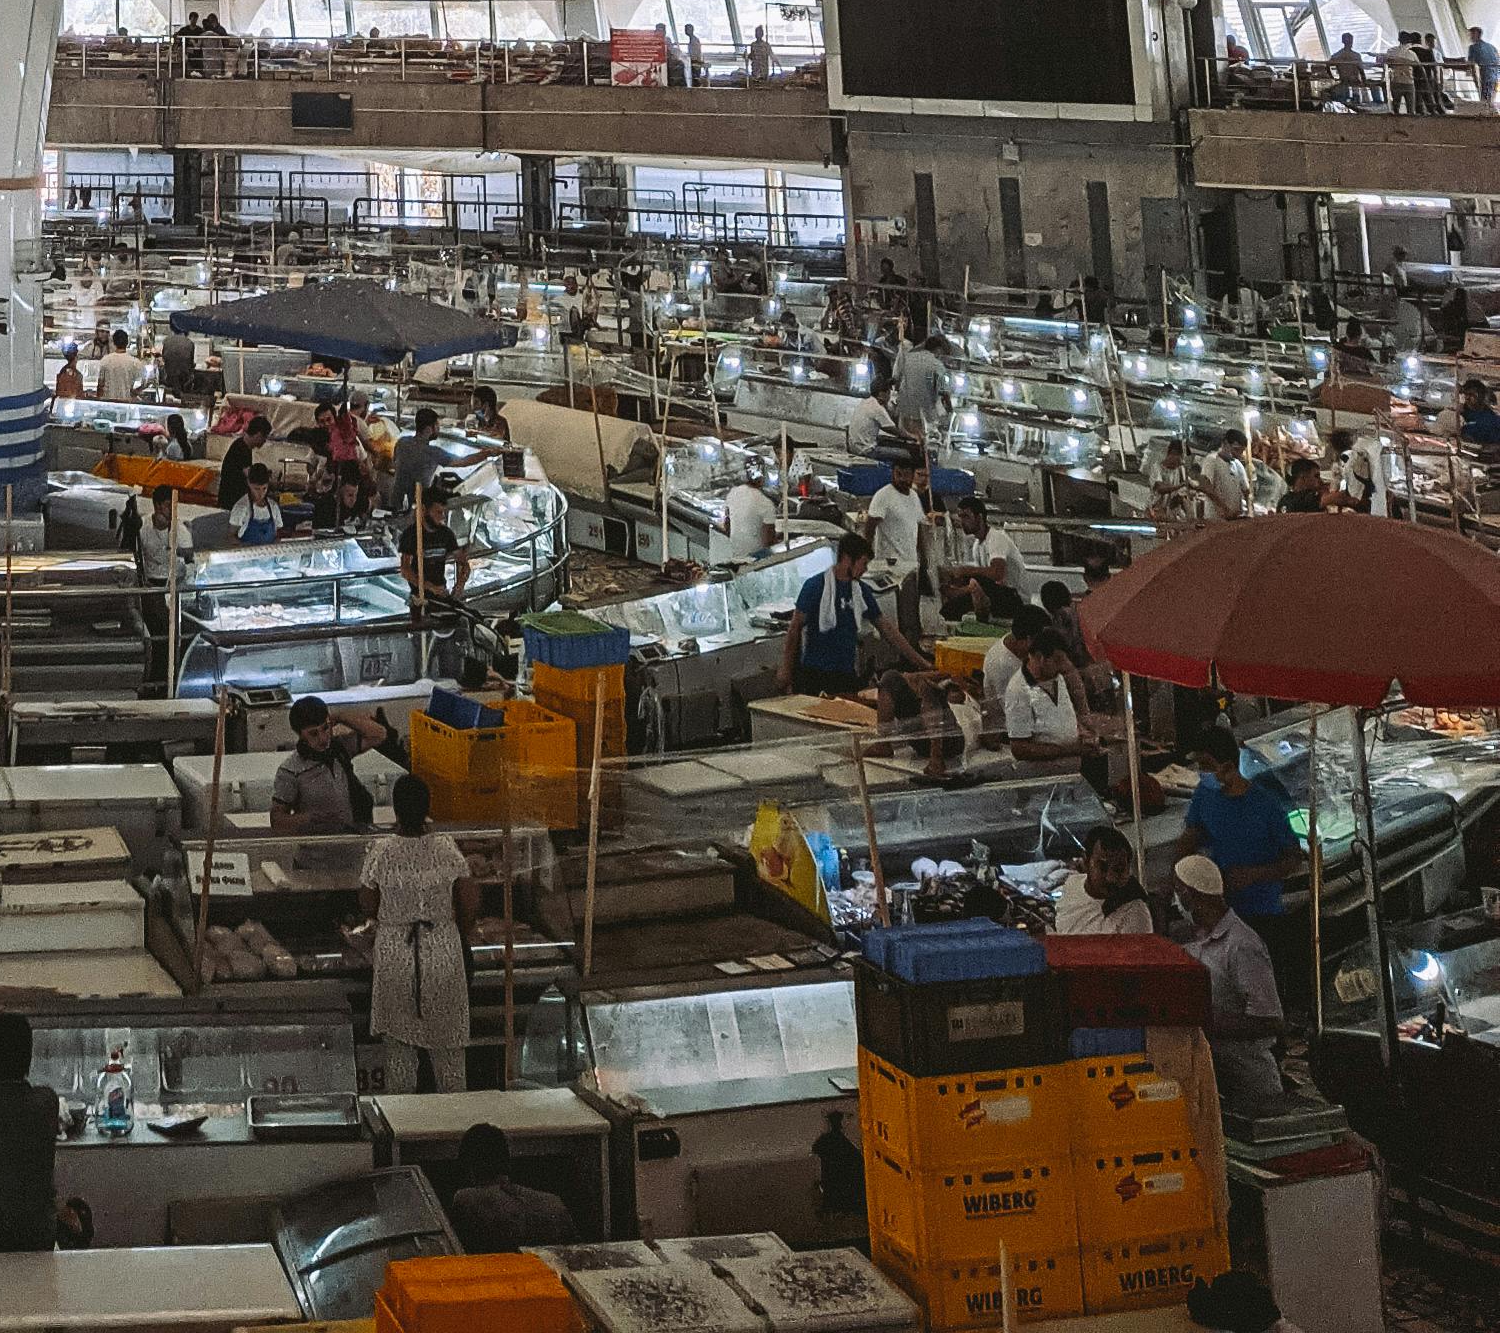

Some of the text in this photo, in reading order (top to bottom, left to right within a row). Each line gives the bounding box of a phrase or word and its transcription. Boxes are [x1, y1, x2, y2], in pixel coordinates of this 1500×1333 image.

[963, 1189, 1037, 1213] WIBERG
[1119, 1264, 1195, 1291] WIBERG
[966, 1287, 1043, 1313] WIBRG
